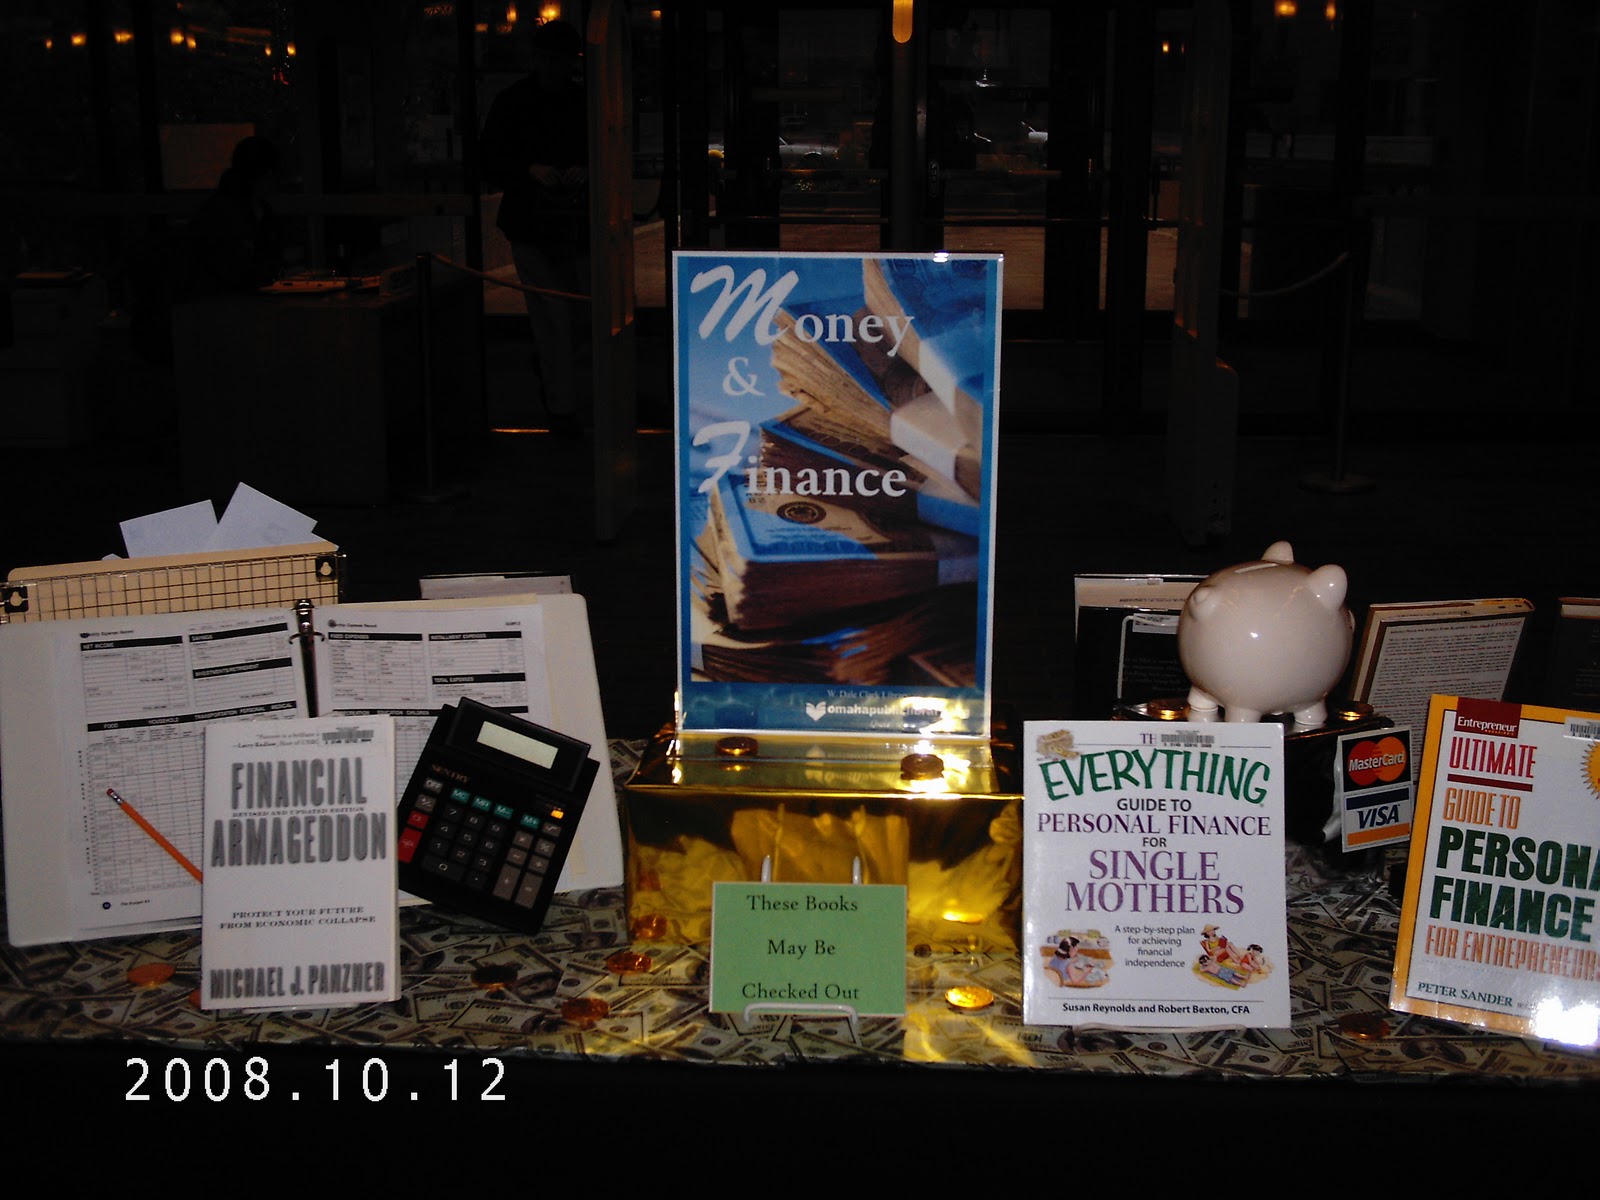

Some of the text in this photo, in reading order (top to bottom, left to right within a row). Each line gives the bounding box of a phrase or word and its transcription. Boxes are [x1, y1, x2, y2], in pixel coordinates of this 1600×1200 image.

[690, 265, 915, 357] Money
[722, 356, 766, 397] &
[692, 420, 907, 498] Finance
[1458, 716, 1518, 732] Entrepreneur
[1348, 752, 1405, 772] MasterCard
[1448, 736, 1538, 779] ULTIMATE
[231, 757, 368, 810] FINANCIAL
[1039, 748, 1271, 804] EVERYTHING
[1116, 798, 1192, 812] GUIDE TO
[1357, 804, 1400, 829] VISA
[1442, 787, 1521, 830] GUIDE TO
[1037, 813, 1272, 837] PERSONAL FINANCE
[211, 812, 387, 867] ARMAGEDDON
[1142, 836, 1167, 848] FOR
[1089, 849, 1220, 882] SINGLE
[746, 894, 858, 912] These Books
[1065, 882, 1244, 915] MOTHERS
[1430, 875, 1595, 943] FINANCE
[232, 906, 364, 919] PROTECT YOUR FUTURE
[255, 918, 316, 928] ECONOMIC
[318, 916, 376, 925] COLLAPSE
[1122, 926, 1175, 935] step-by-step
[1176, 926, 1196, 934] plan
[1128, 936, 1182, 947] for achieving
[1424, 925, 1460, 959] FOR
[768, 939, 836, 960] May Be
[1138, 947, 1172, 956] financial
[1125, 958, 1186, 968] independence
[210, 962, 385, 999] MICHAEL J. PANZNER
[742, 982, 860, 1000] Checked Out
[1418, 981, 1457, 998] PETER
[1460, 989, 1513, 1007] SANDER
[1062, 1004, 1250, 1014] Susan Reynolds and Robert Bexton, CFA
